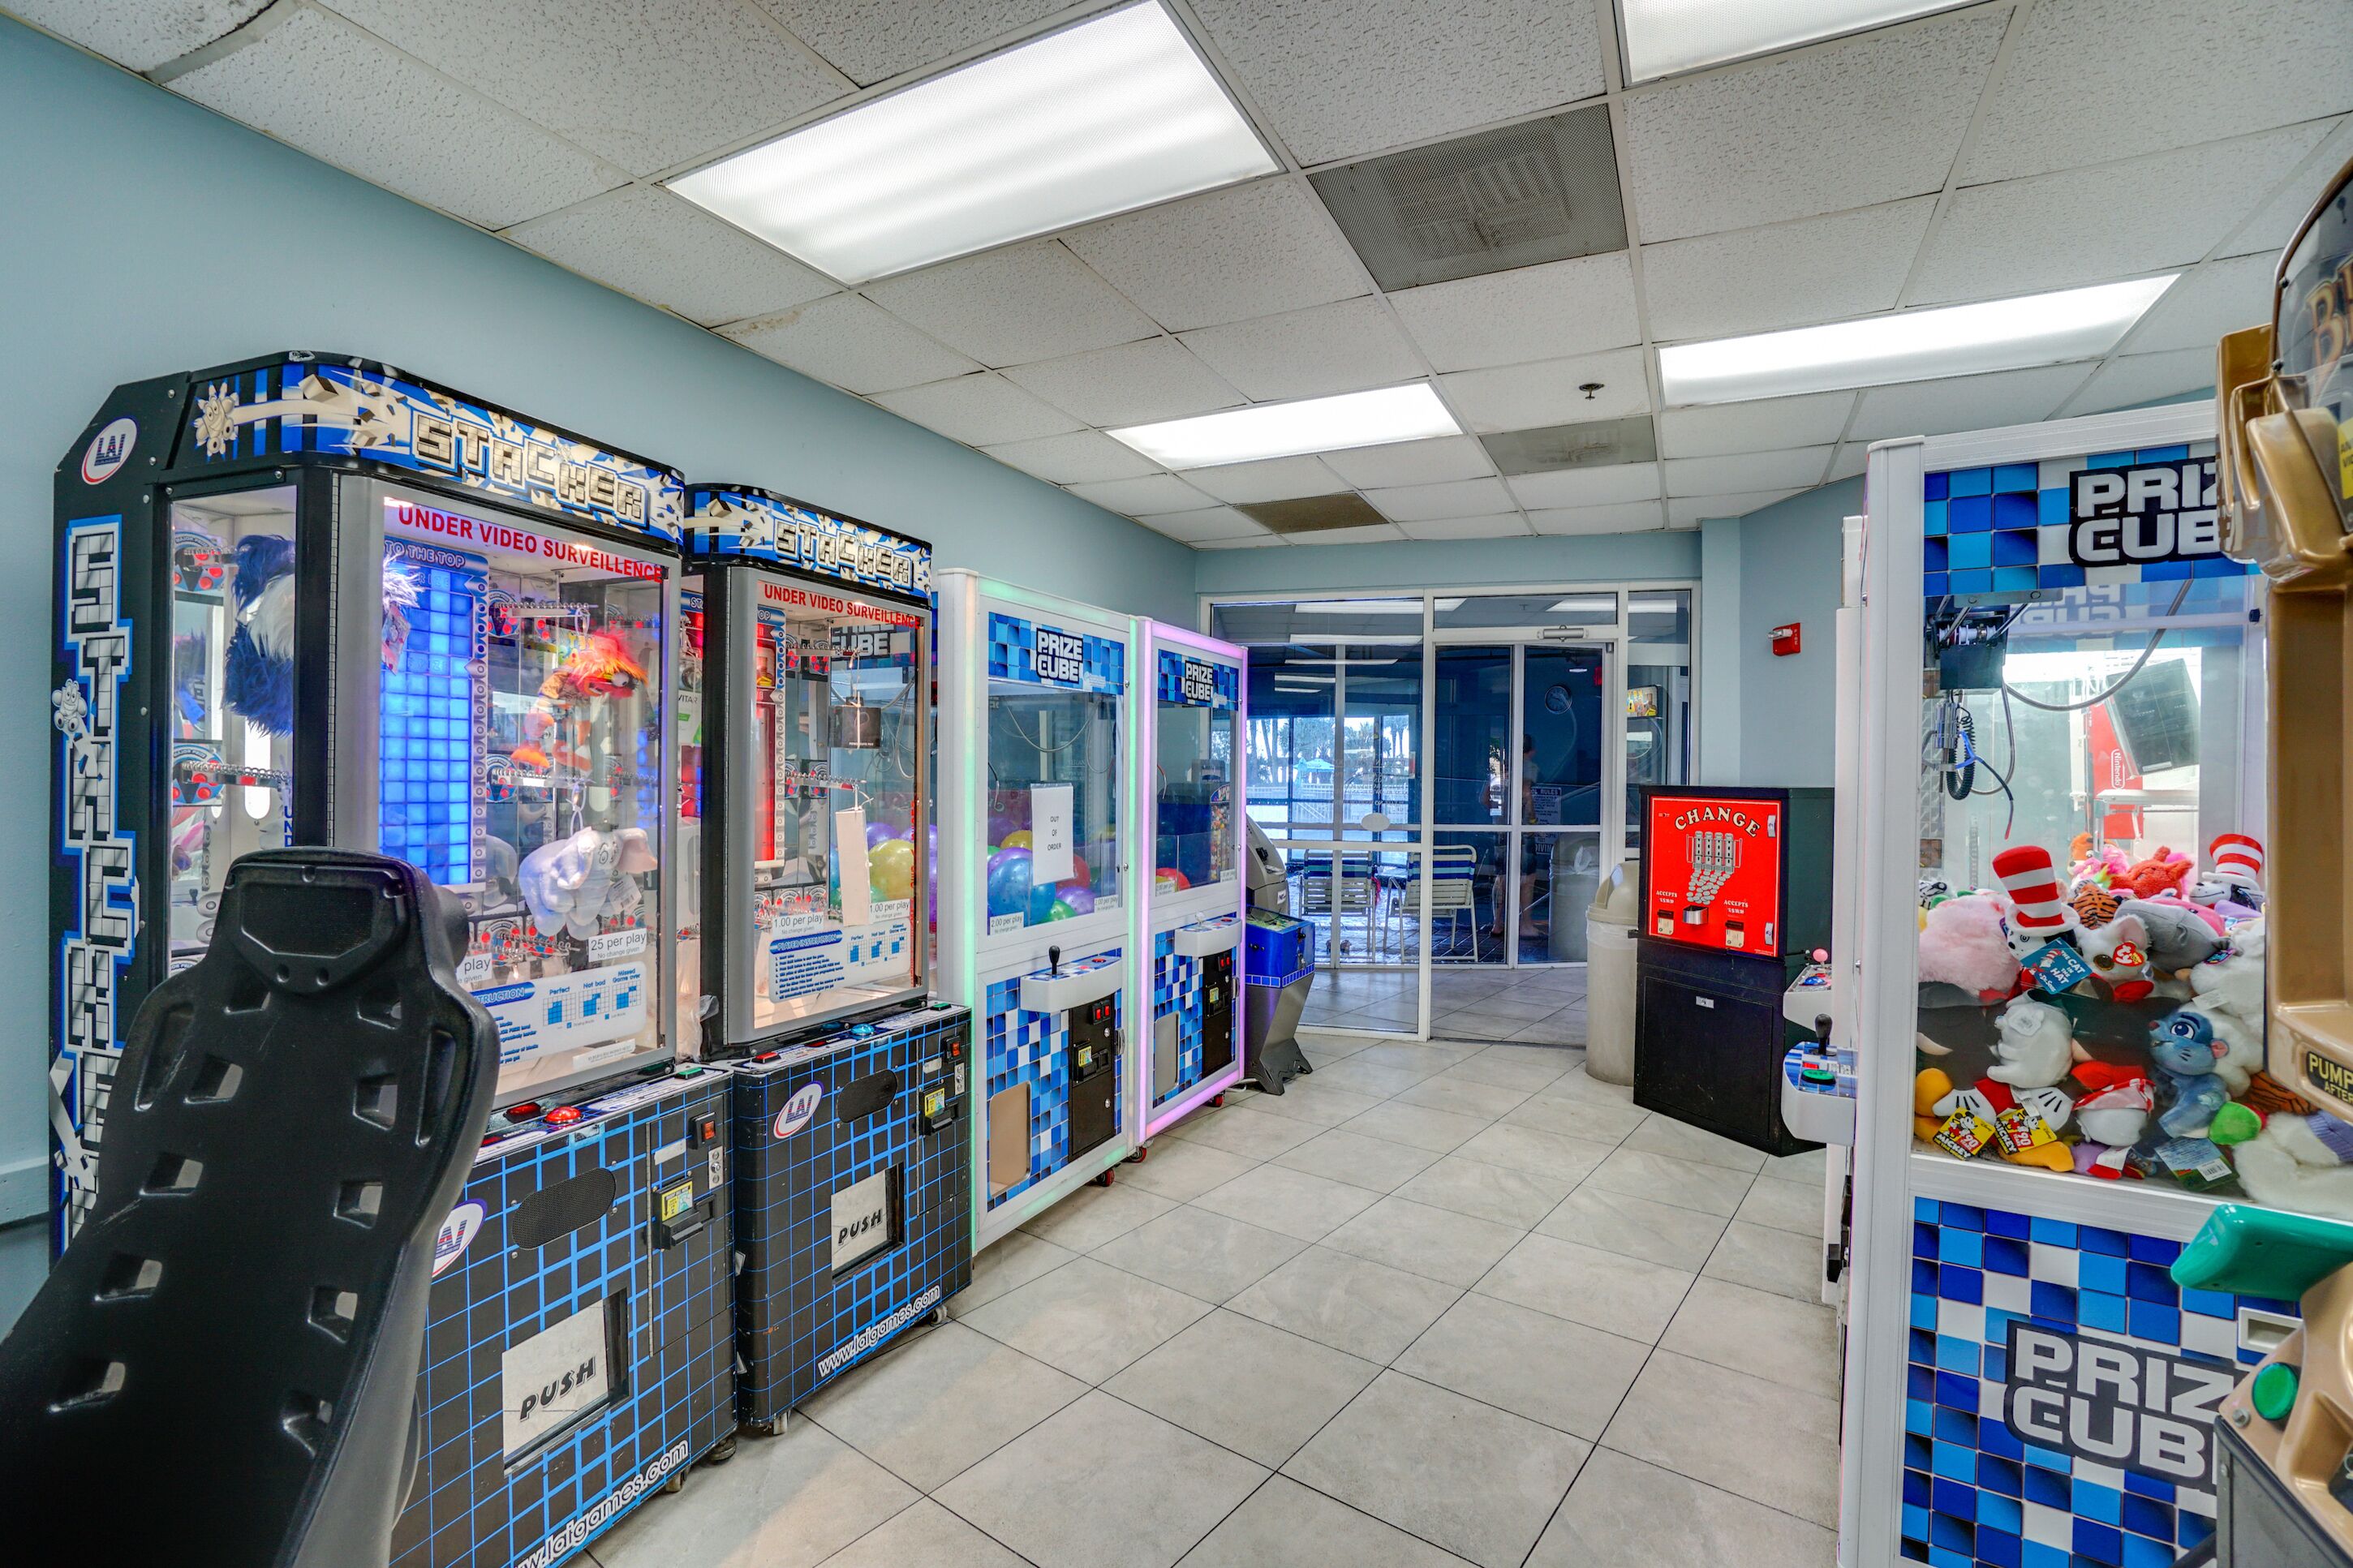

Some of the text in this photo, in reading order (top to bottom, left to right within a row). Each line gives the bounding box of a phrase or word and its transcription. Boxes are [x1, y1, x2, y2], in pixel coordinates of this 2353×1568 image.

[415, 413, 647, 521] STACKER
[2077, 461, 2217, 518] PRI
[398, 505, 663, 583] UNDER VIDEO SURVEILLENCE
[776, 520, 911, 586] STACKER
[407, 545, 436, 563] THE
[436, 552, 466, 569] TOP
[764, 582, 921, 629] UNDER VIDEO SURVEILLENCE
[1038, 630, 1083, 662] PRIZE
[1037, 654, 1080, 683] CUBE
[1185, 662, 1213, 684] PRIZE
[1185, 680, 1211, 702] CUBE
[1675, 806, 1761, 837] CHANGE
[1047, 843, 1062, 851] ORDER
[884, 903, 895, 913] per
[897, 900, 910, 910] play
[793, 916, 806, 927] per
[807, 913, 824, 925] play
[1003, 917, 1012, 926] per
[1013, 914, 1022, 924] play
[607, 937, 623, 951] per
[626, 932, 647, 947] play
[607, 948, 626, 958] change
[626, 946, 640, 955] given
[464, 958, 492, 975] play
[617, 968, 636, 977] Missed
[2050, 967, 2070, 984] HAT
[2067, 958, 2086, 974] CAT
[463, 973, 483, 985] given
[549, 986, 570, 996] Perfect
[594, 979, 606, 988] bad
[612, 975, 629, 983] Game
[2309, 1052, 2353, 1090] PUMP
[1935, 1133, 1972, 1158] MICKEY
[1995, 1120, 2018, 1152] MICKEY
[837, 1208, 884, 1246] PUSH
[817, 1284, 941, 1378] www.laigames.com
[2015, 1327, 2234, 1424] PRIZ
[518, 1355, 597, 1423] PUSH
[2011, 1385, 2218, 1486] CUB
